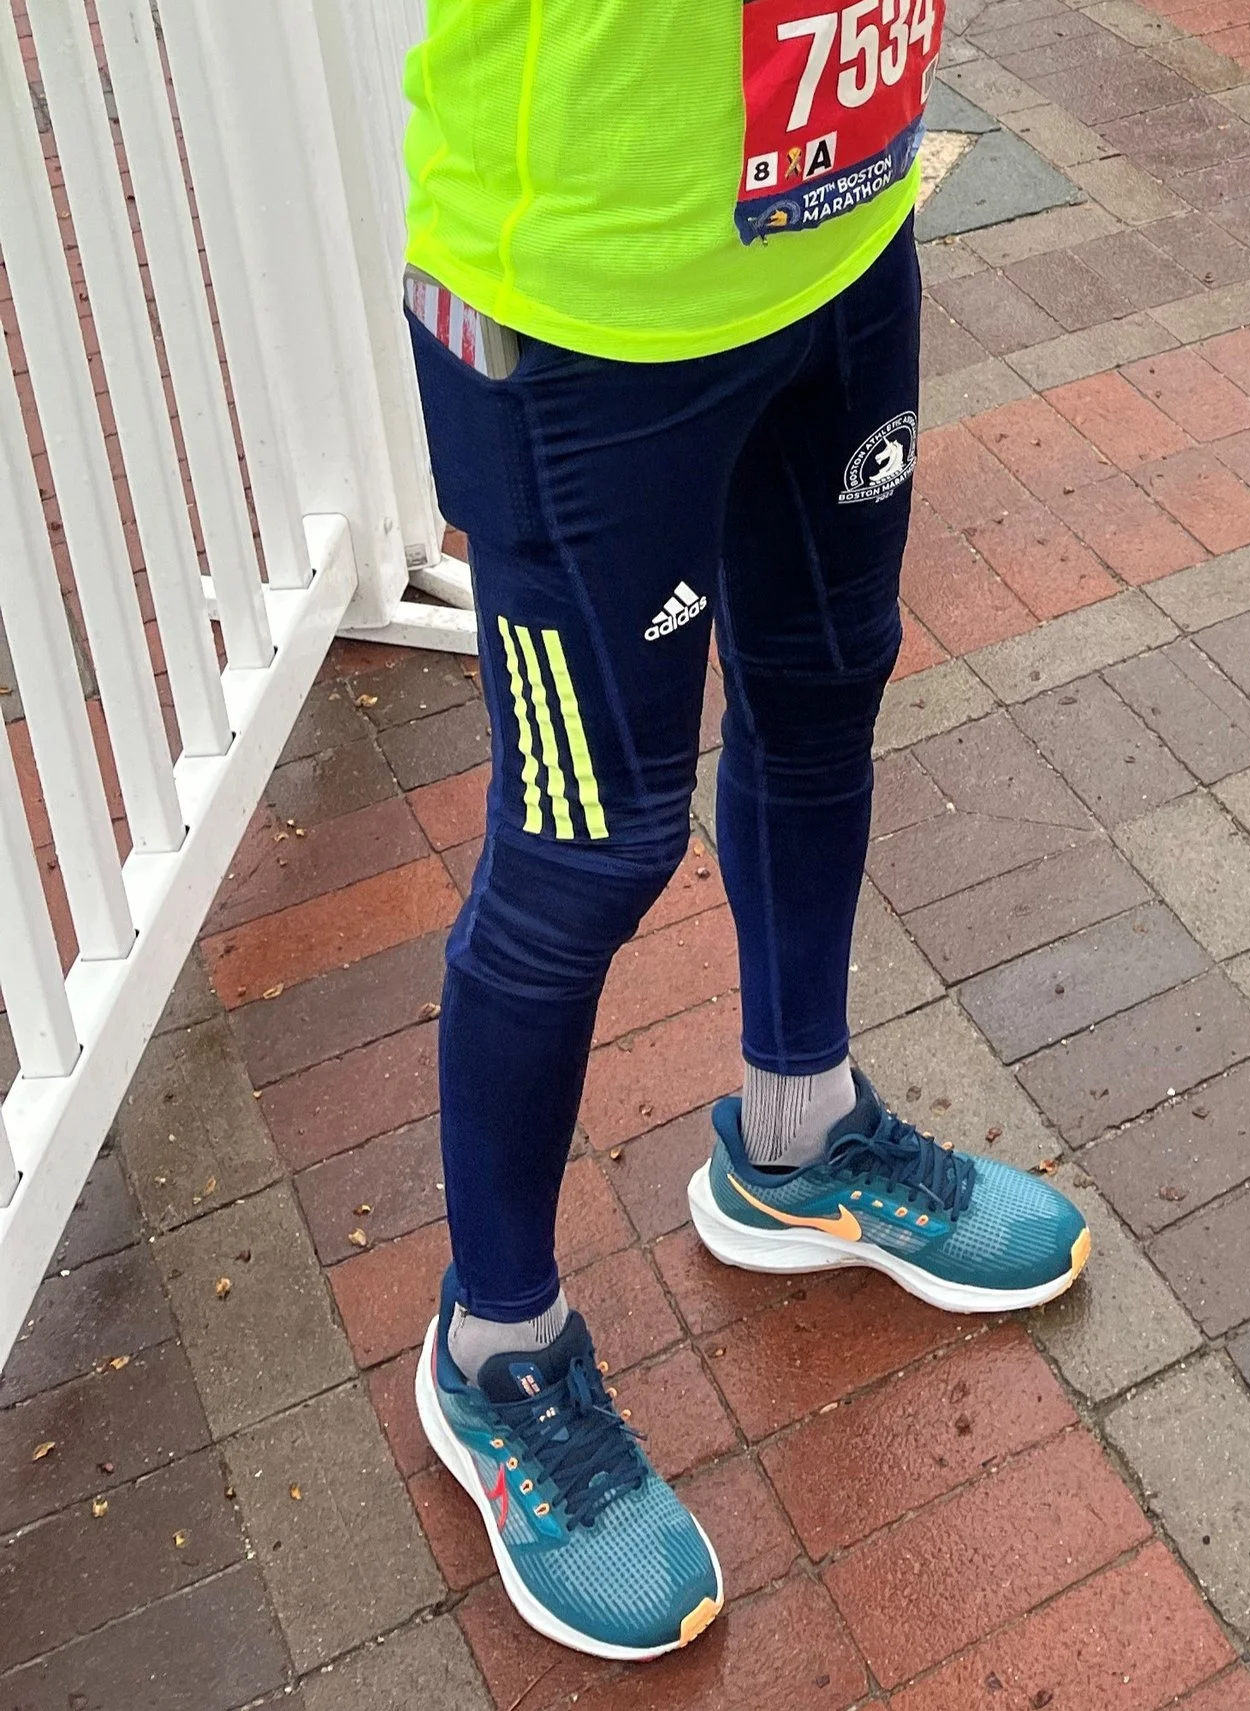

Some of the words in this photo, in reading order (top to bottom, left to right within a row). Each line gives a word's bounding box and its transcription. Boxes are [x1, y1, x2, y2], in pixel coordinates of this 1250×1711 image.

[753, 160, 771, 182] 8
[806, 139, 832, 177] A
[802, 181, 836, 208] 127TH
[837, 153, 893, 194] BOSTON
[802, 170, 893, 223] MARATHON
[849, 451, 866, 487] BOSTON
[865, 417, 903, 451] ATHLETIC
[838, 487, 881, 501] BOSTON
[644, 596, 707, 641] adidas
